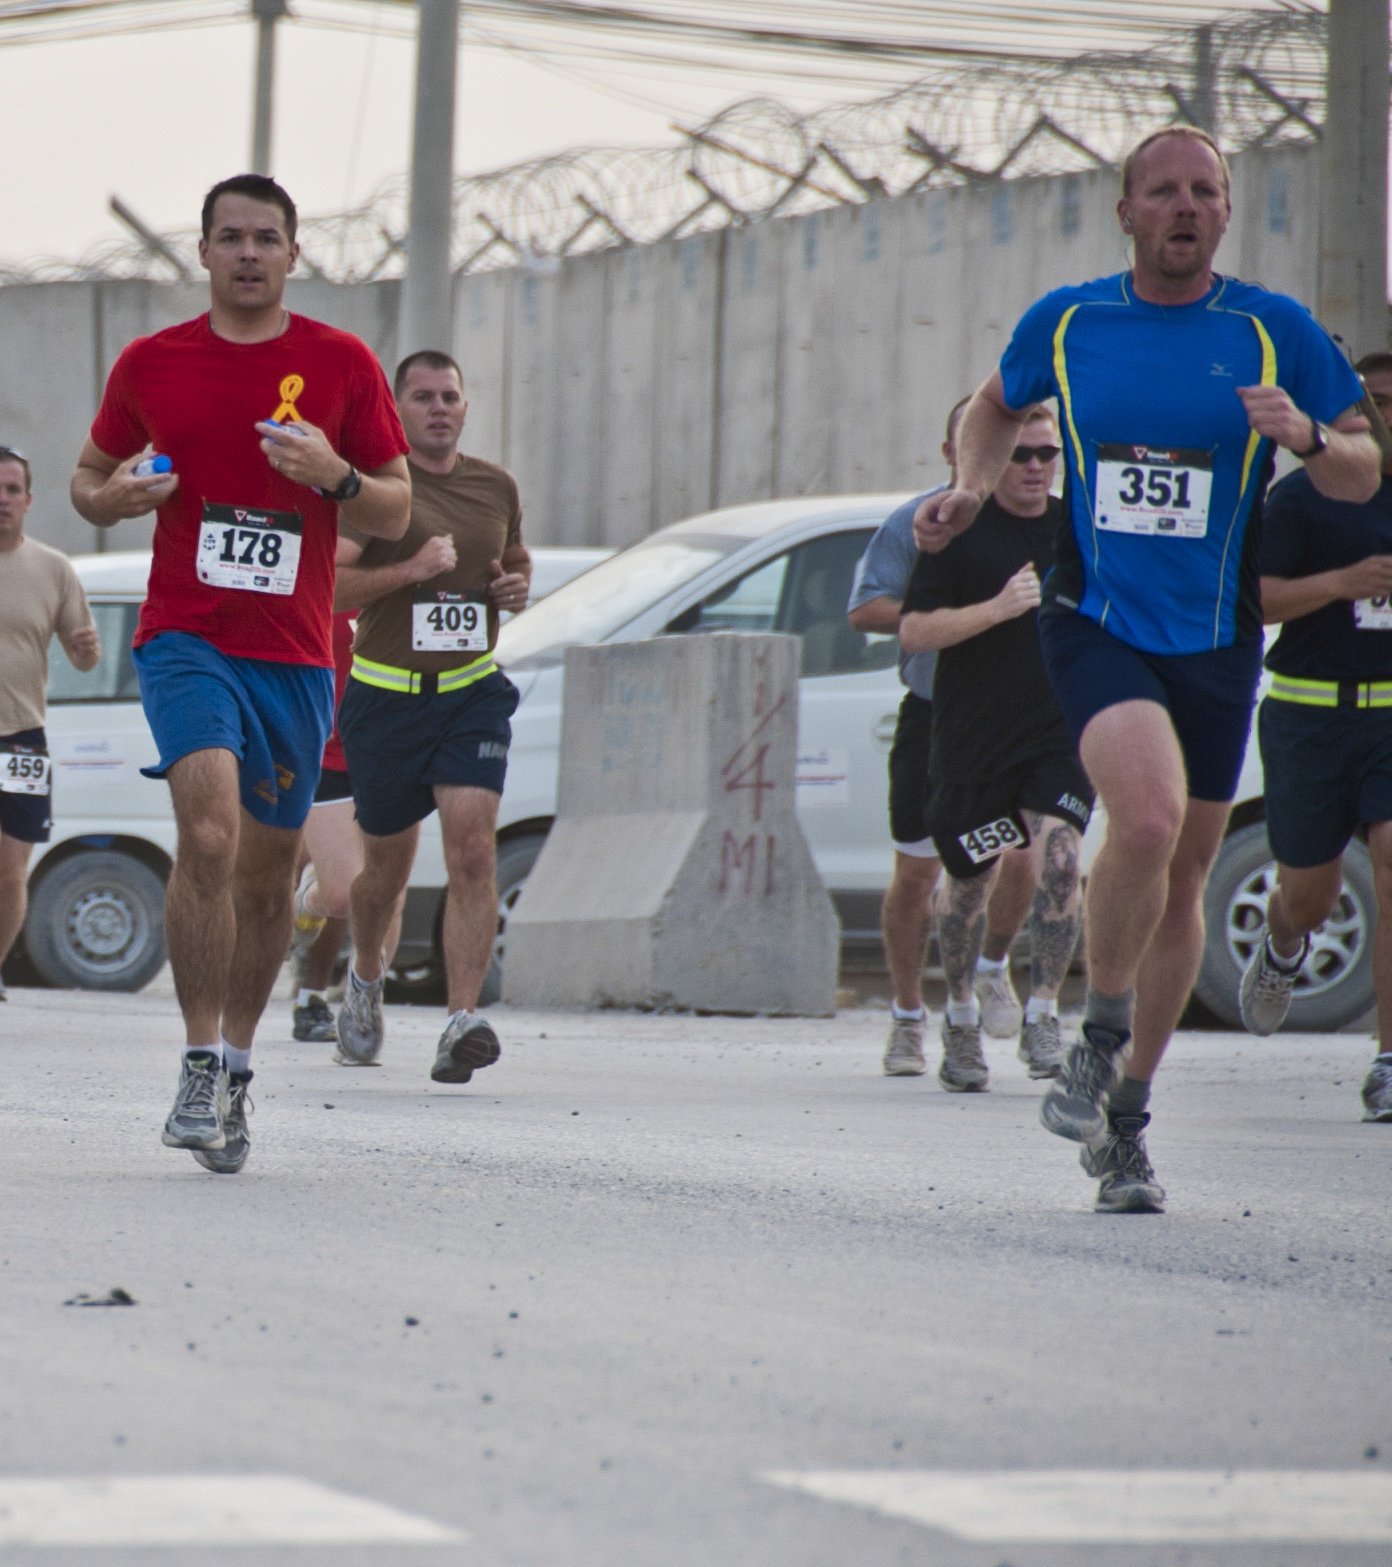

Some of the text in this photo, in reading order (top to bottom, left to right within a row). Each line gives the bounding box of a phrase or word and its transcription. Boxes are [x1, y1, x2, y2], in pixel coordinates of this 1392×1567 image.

[1119, 466, 1191, 509] 351
[219, 528, 282, 569] 178
[426, 606, 477, 631] 409
[8, 756, 44, 779] 459
[967, 820, 1018, 856] 458
